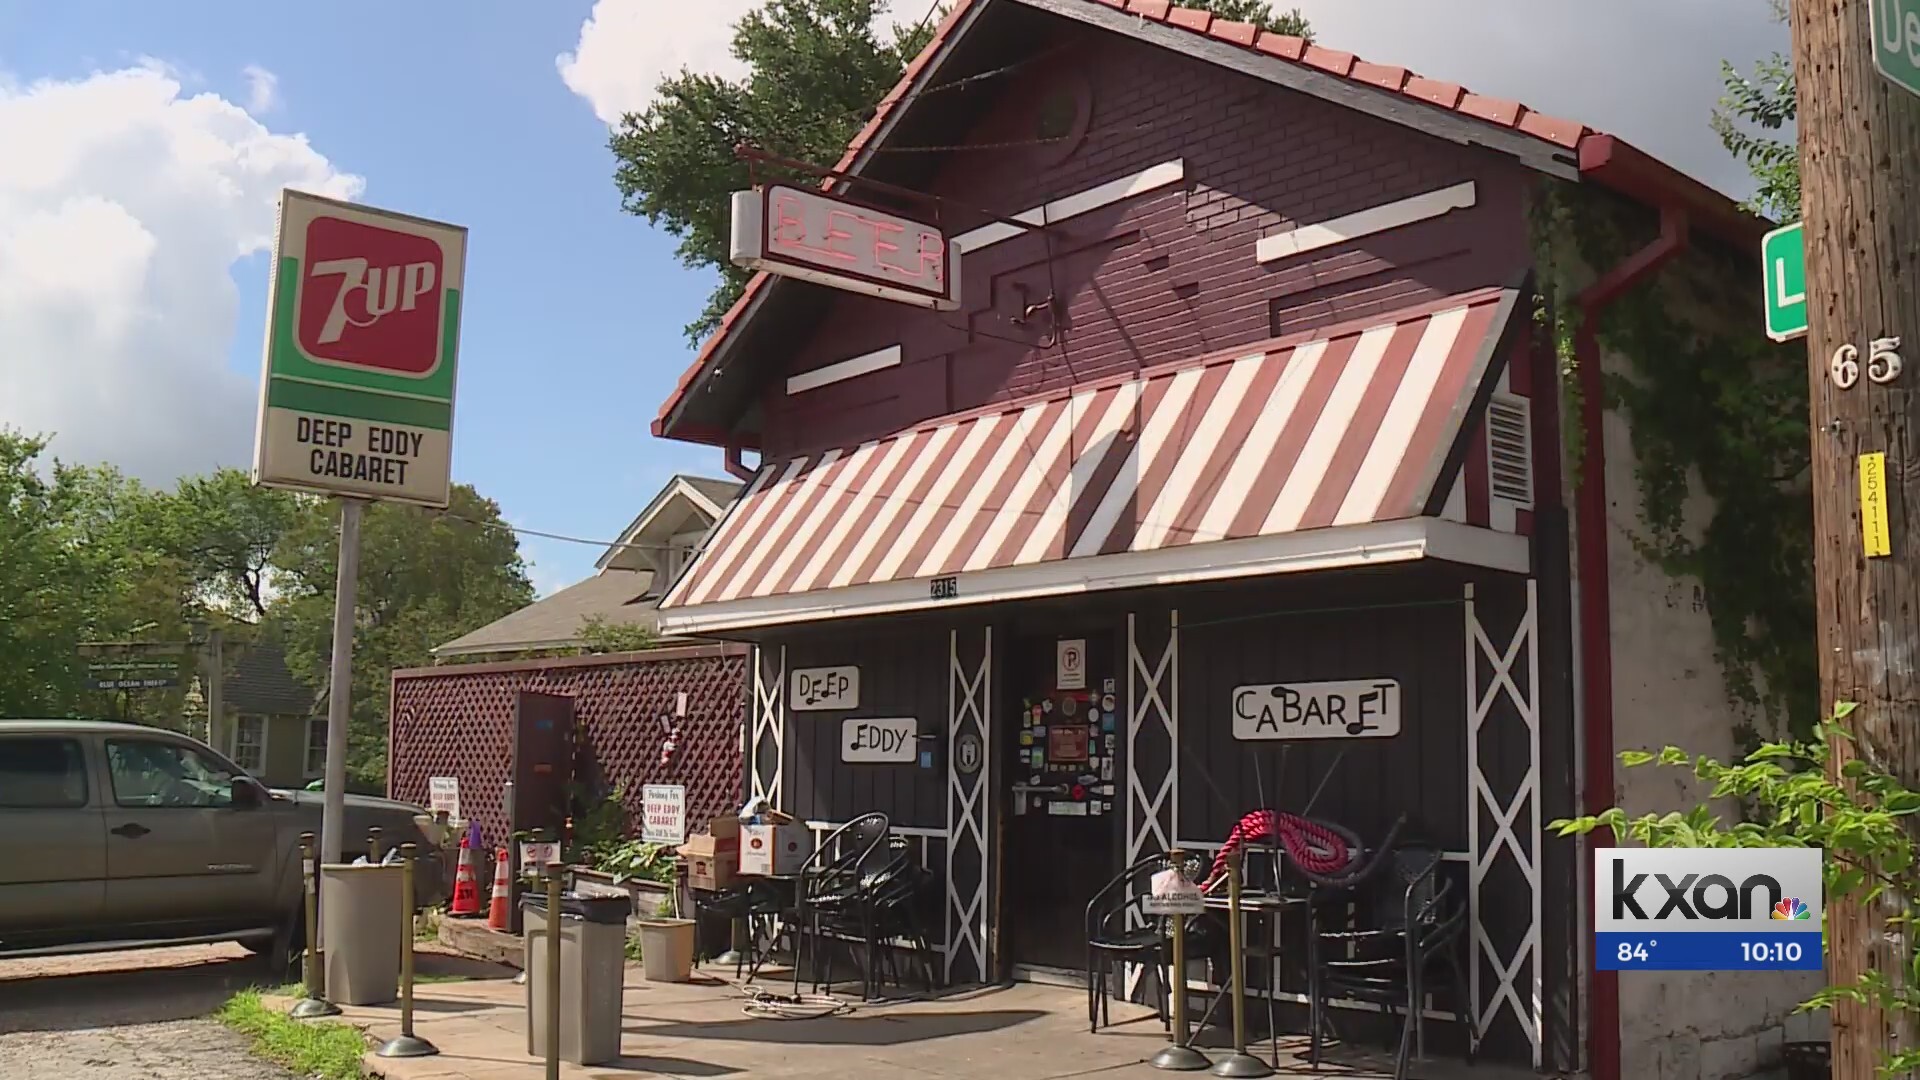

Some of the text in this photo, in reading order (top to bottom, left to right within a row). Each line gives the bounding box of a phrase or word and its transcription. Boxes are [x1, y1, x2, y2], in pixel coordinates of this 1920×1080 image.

[777, 196, 944, 281] BEER
[311, 257, 436, 345] 7UP
[1831, 336, 1902, 389] 65
[297, 417, 424, 458] DEEP EDDY
[310, 449, 409, 485] CABARET
[1867, 462, 1880, 548] 254111
[930, 578, 957, 597] 2315
[800, 672, 849, 706] DEEP
[1235, 685, 1396, 736] CABARET
[850, 723, 908, 754] EDDY
[648, 815, 678, 826] CABARET
